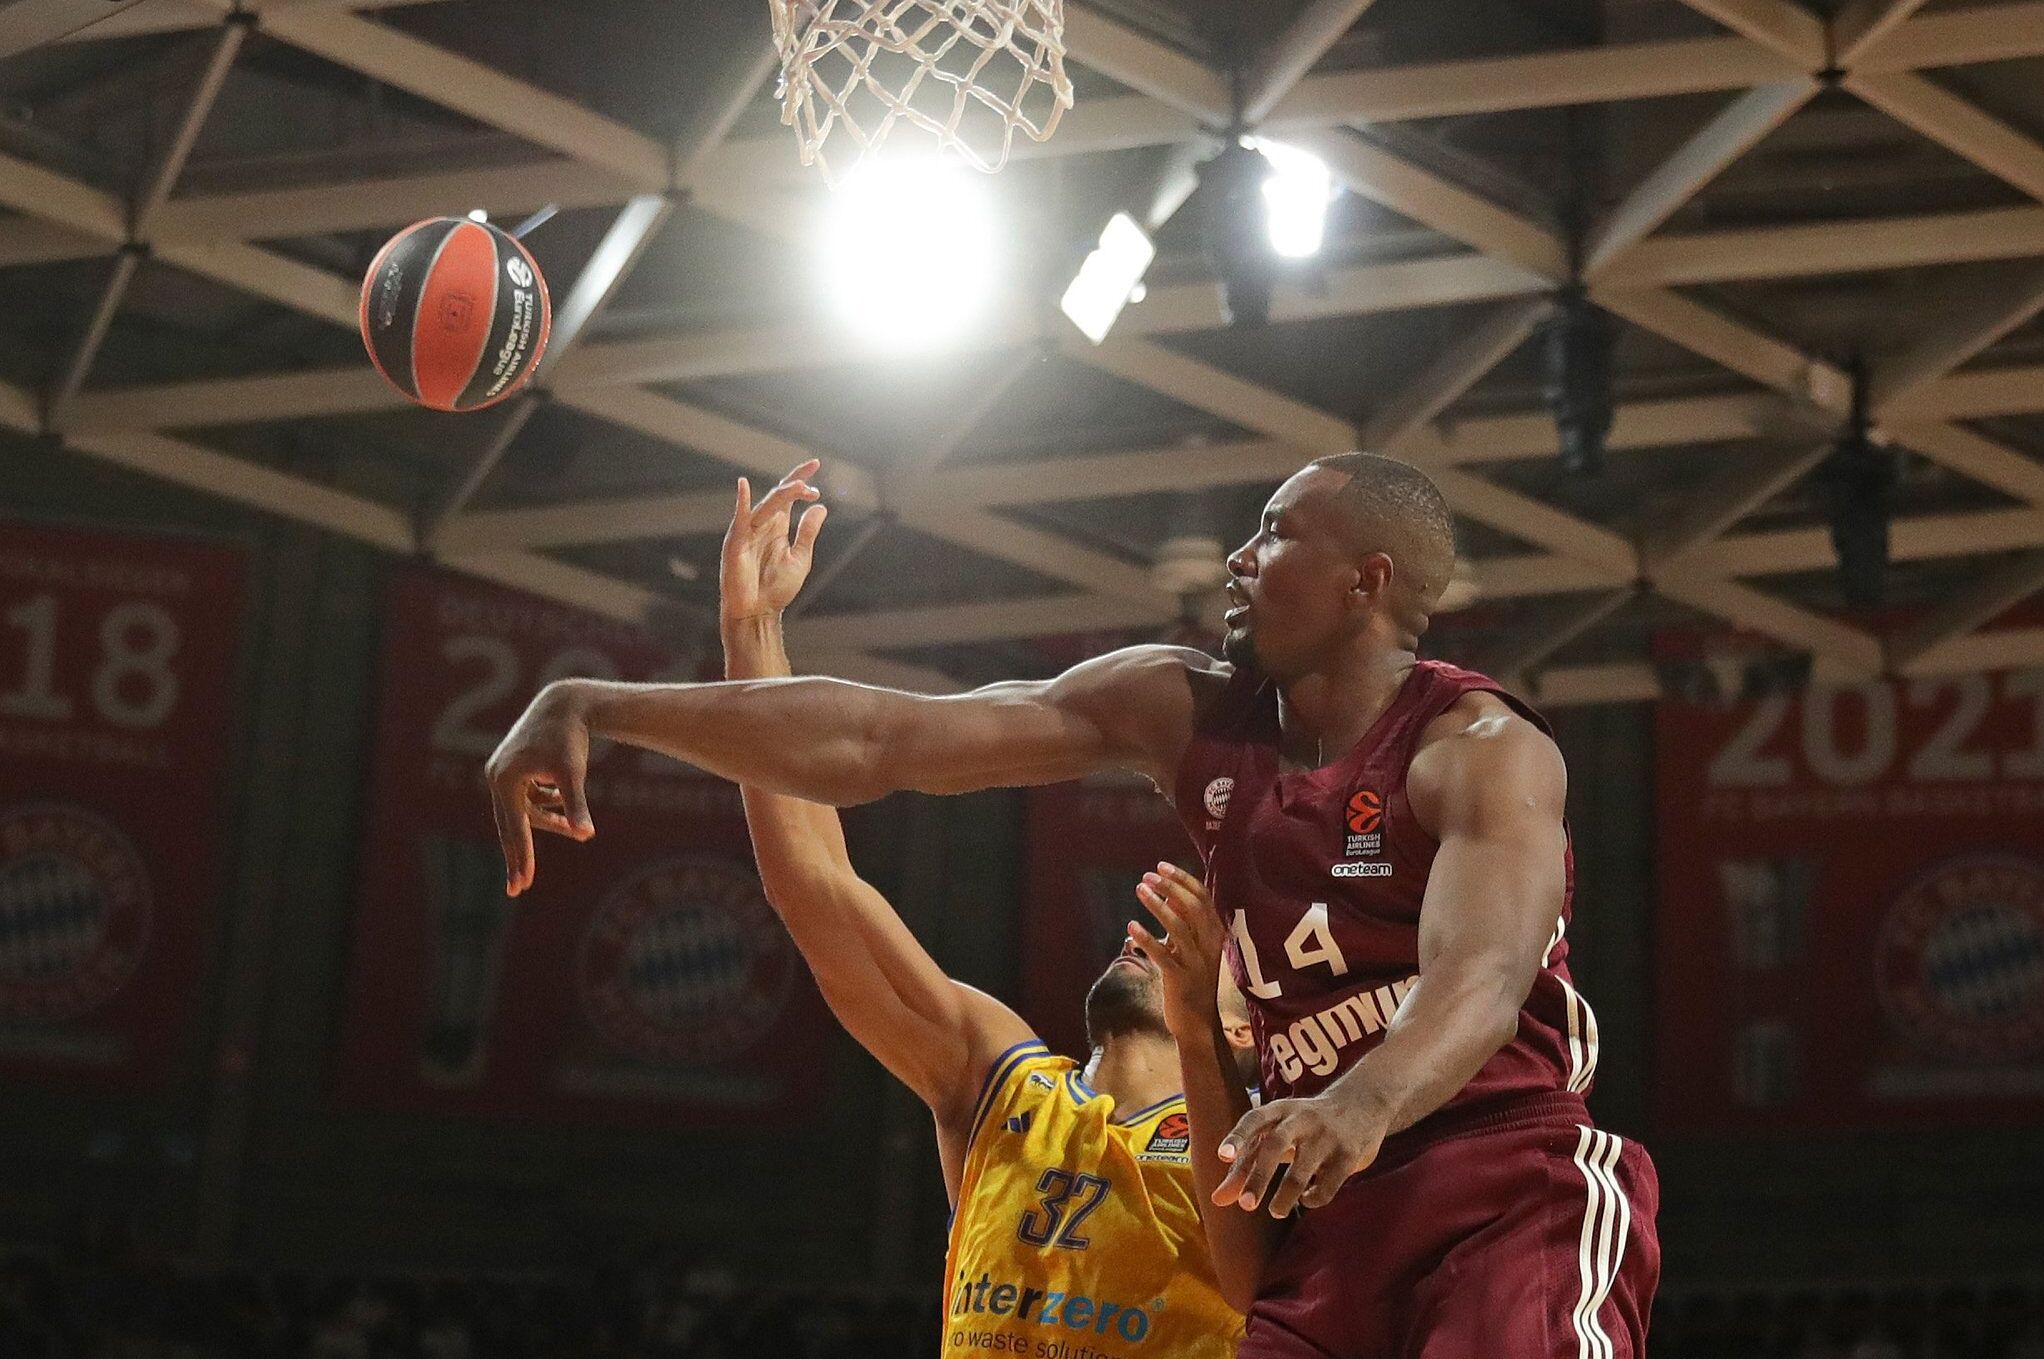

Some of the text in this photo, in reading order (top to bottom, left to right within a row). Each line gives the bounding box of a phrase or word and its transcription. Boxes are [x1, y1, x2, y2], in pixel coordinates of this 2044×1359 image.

[518, 293, 533, 351] TURKISH
[1347, 834, 1380, 842] TURKISH
[1347, 841, 1380, 849] AIRLINES
[1332, 862, 1392, 876] oneteam
[1231, 903, 1348, 999] 14
[1017, 1167, 1112, 1251] 32
[968, 1332, 1029, 1350] waste
